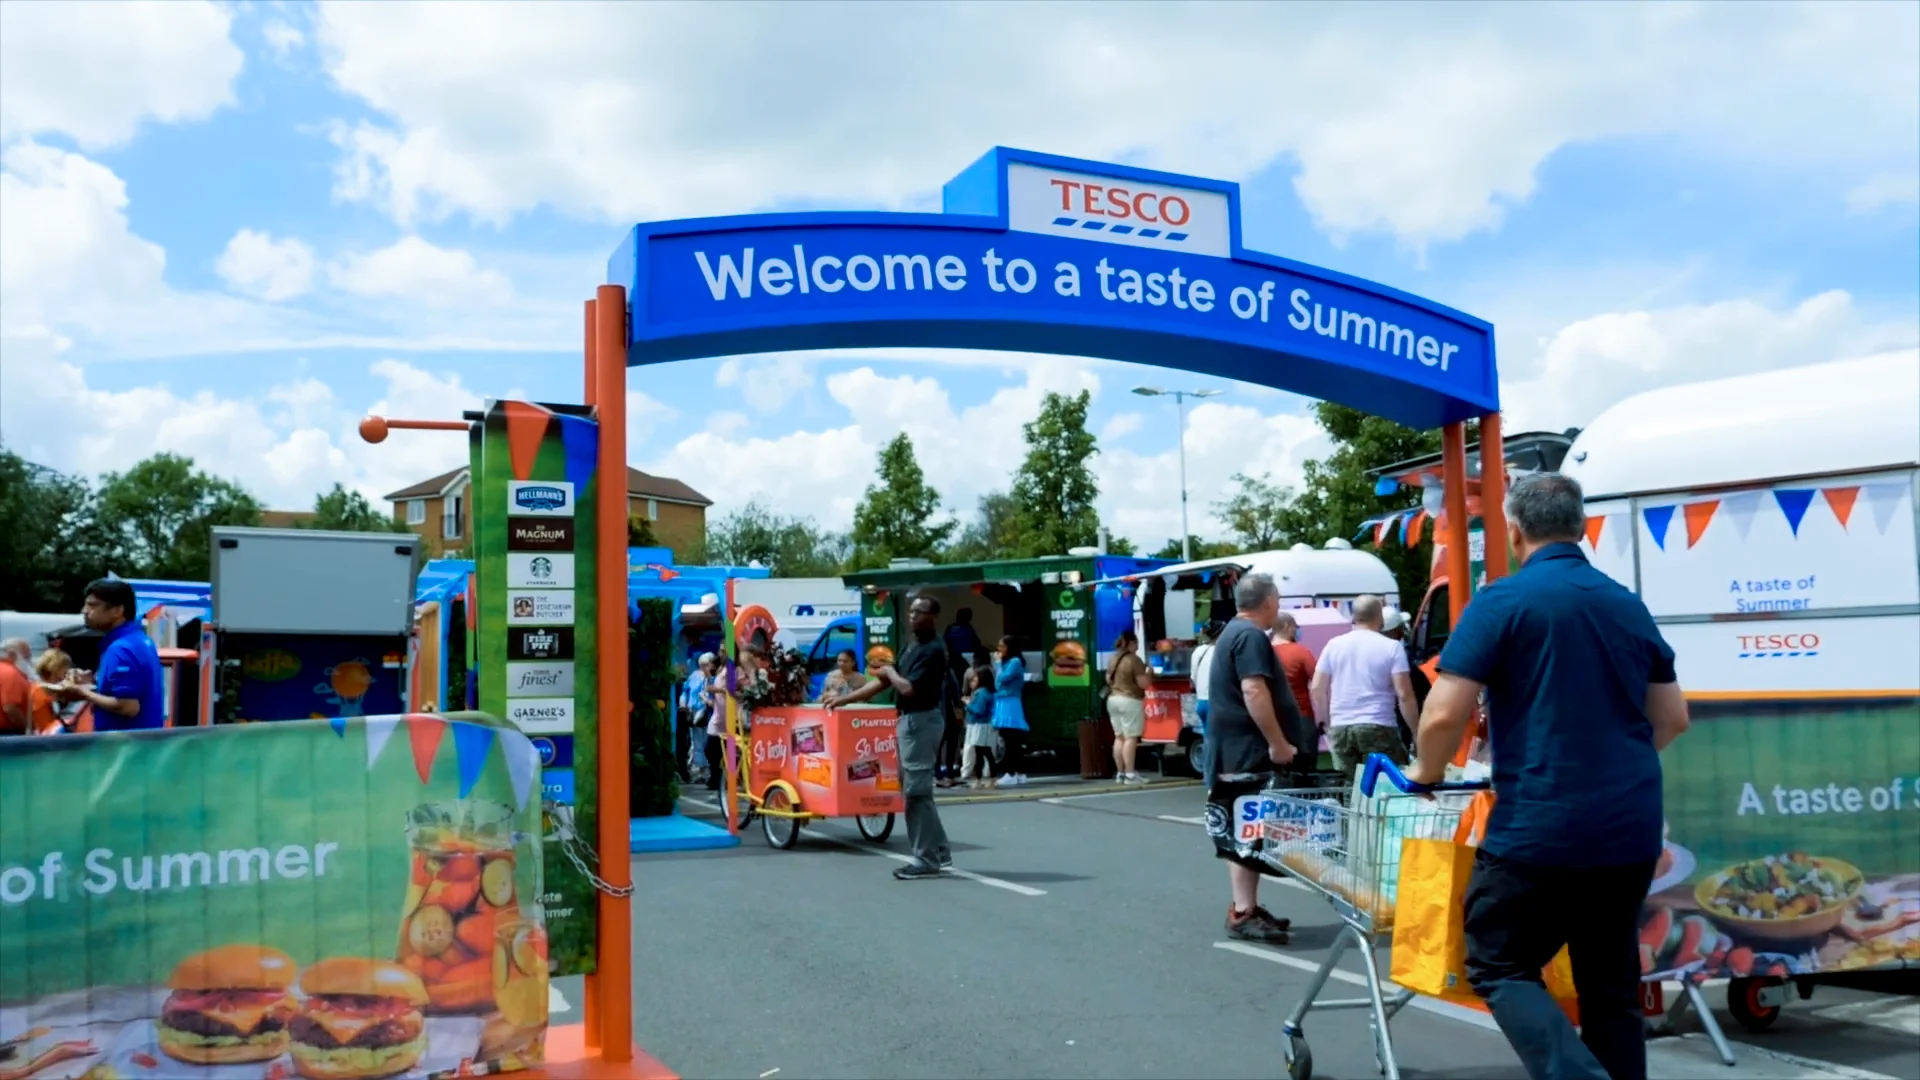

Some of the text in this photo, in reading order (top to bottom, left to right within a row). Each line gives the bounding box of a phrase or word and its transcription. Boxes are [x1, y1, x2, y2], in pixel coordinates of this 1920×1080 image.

[1050, 179, 1191, 227] TESCO
[694, 244, 1459, 372] Welcome to a taste of Summer
[518, 490, 564, 502] HELLMANN'S
[516, 528, 566, 540] MAGNUM
[1730, 574, 1816, 592] A taste of
[1736, 598, 1812, 612] Summer
[528, 635, 554, 643] FIRE
[1736, 633, 1820, 650] TESCO
[517, 671, 559, 690] finest
[860, 719, 897, 728] PLANTAST
[855, 737, 872, 760] So
[1737, 782, 1765, 816] A
[1772, 782, 1863, 815] taste
[1870, 777, 1903, 811] of
[0, 842, 339, 903] of Summer
